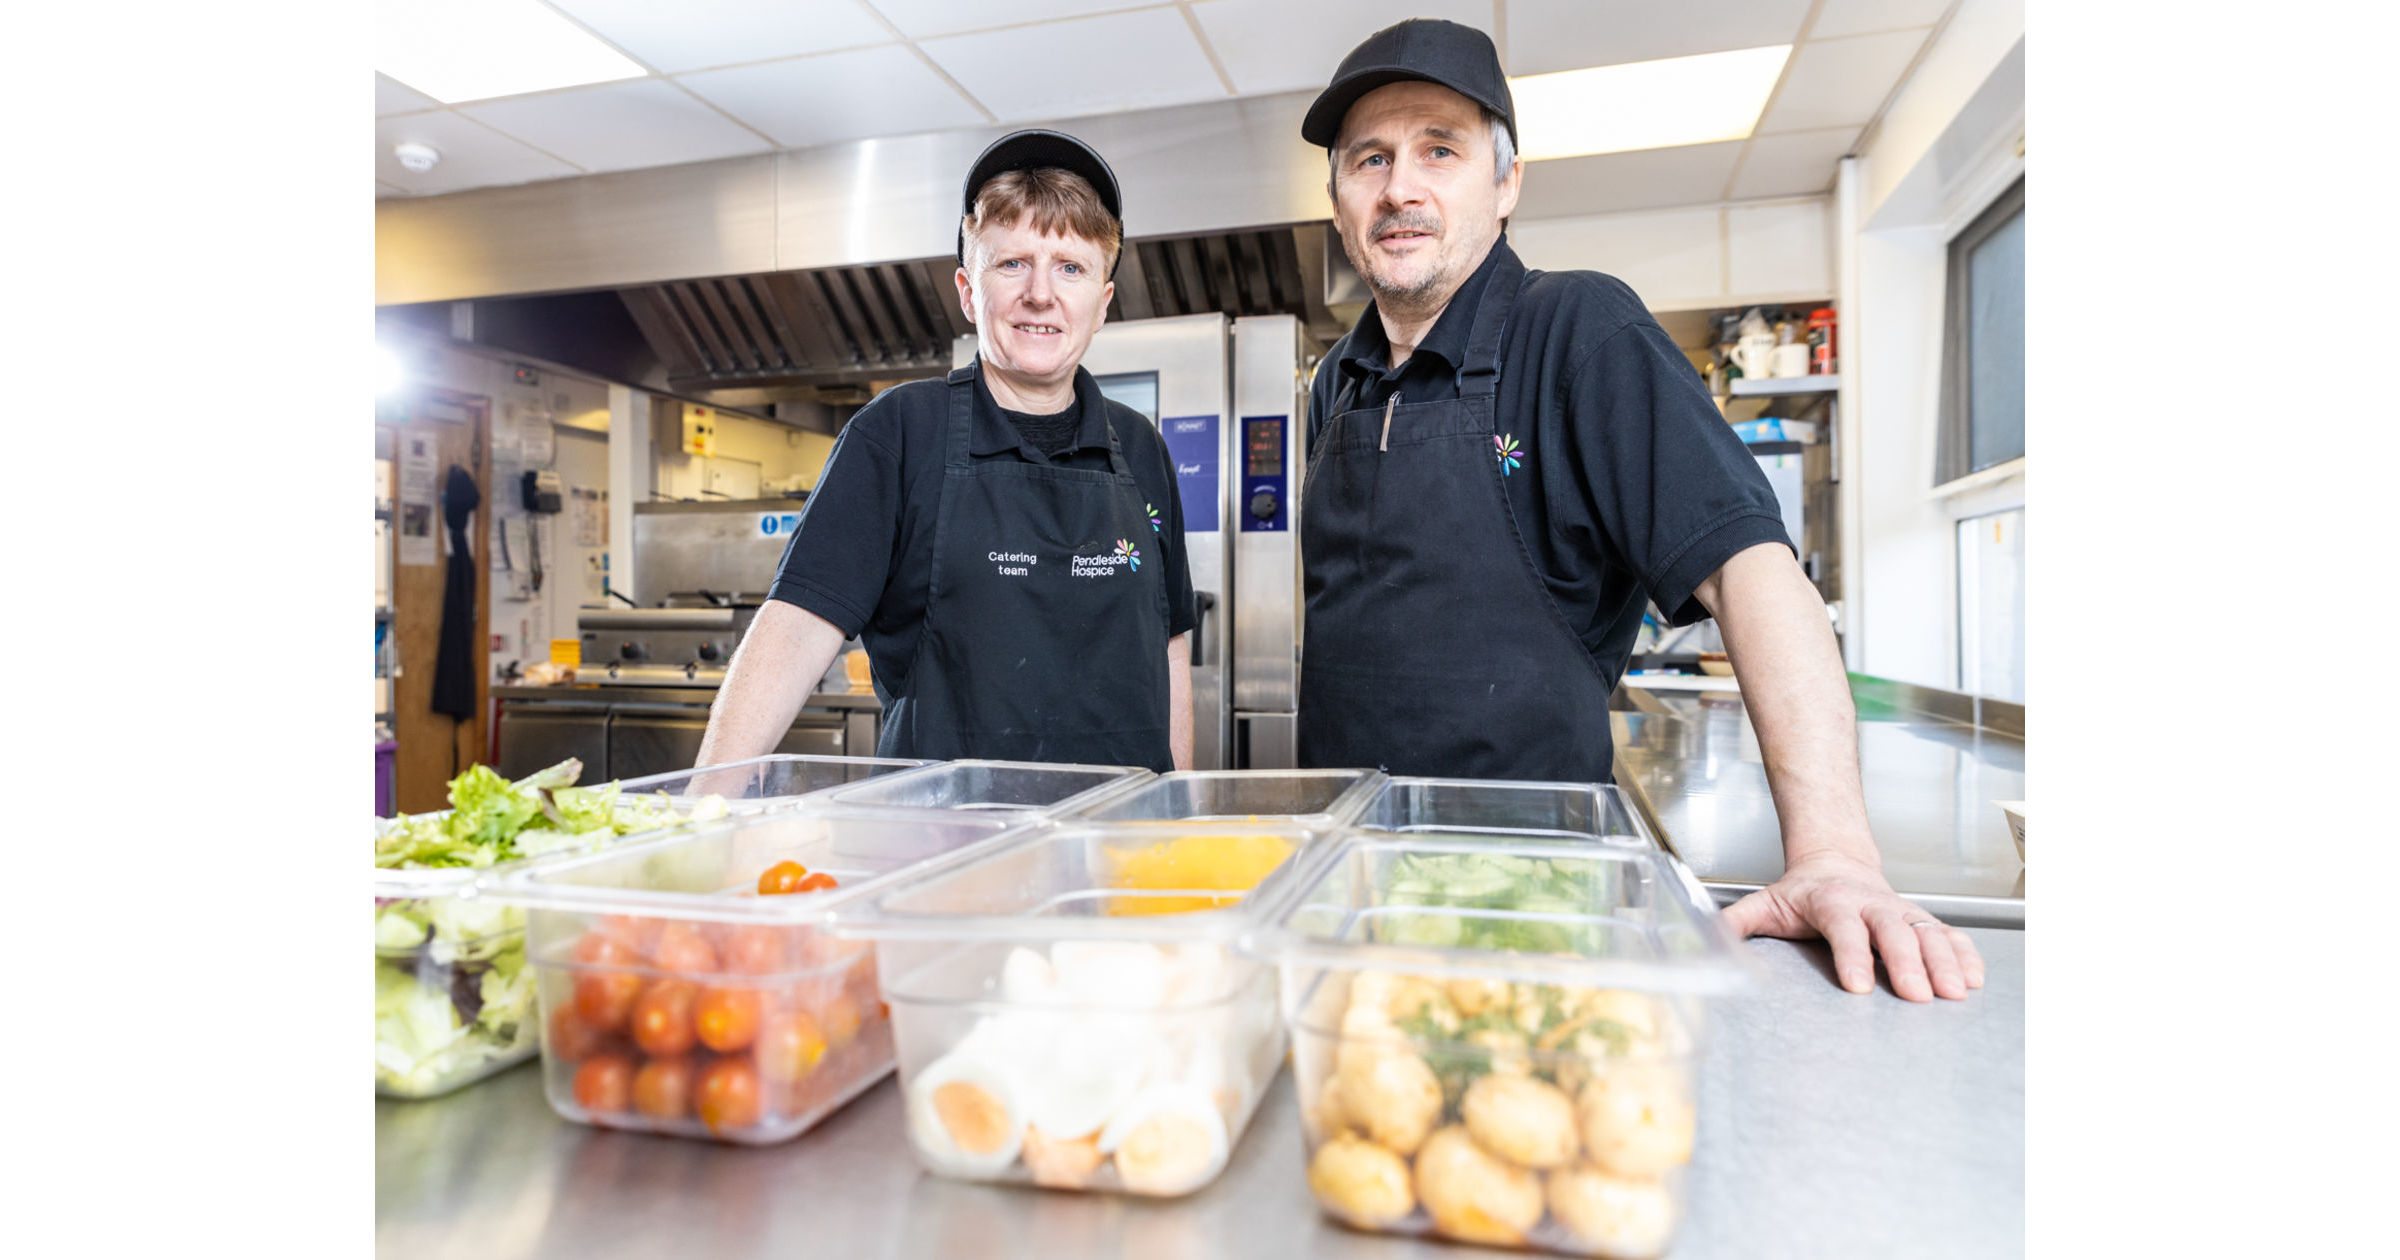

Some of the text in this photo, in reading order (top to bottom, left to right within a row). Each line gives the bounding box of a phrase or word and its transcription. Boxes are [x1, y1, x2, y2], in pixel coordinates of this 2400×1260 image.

[988, 552, 1037, 564] Catering
[1072, 553, 1128, 566] Pendleside
[998, 565, 1028, 576] team
[1071, 565, 1115, 578] Hospice
